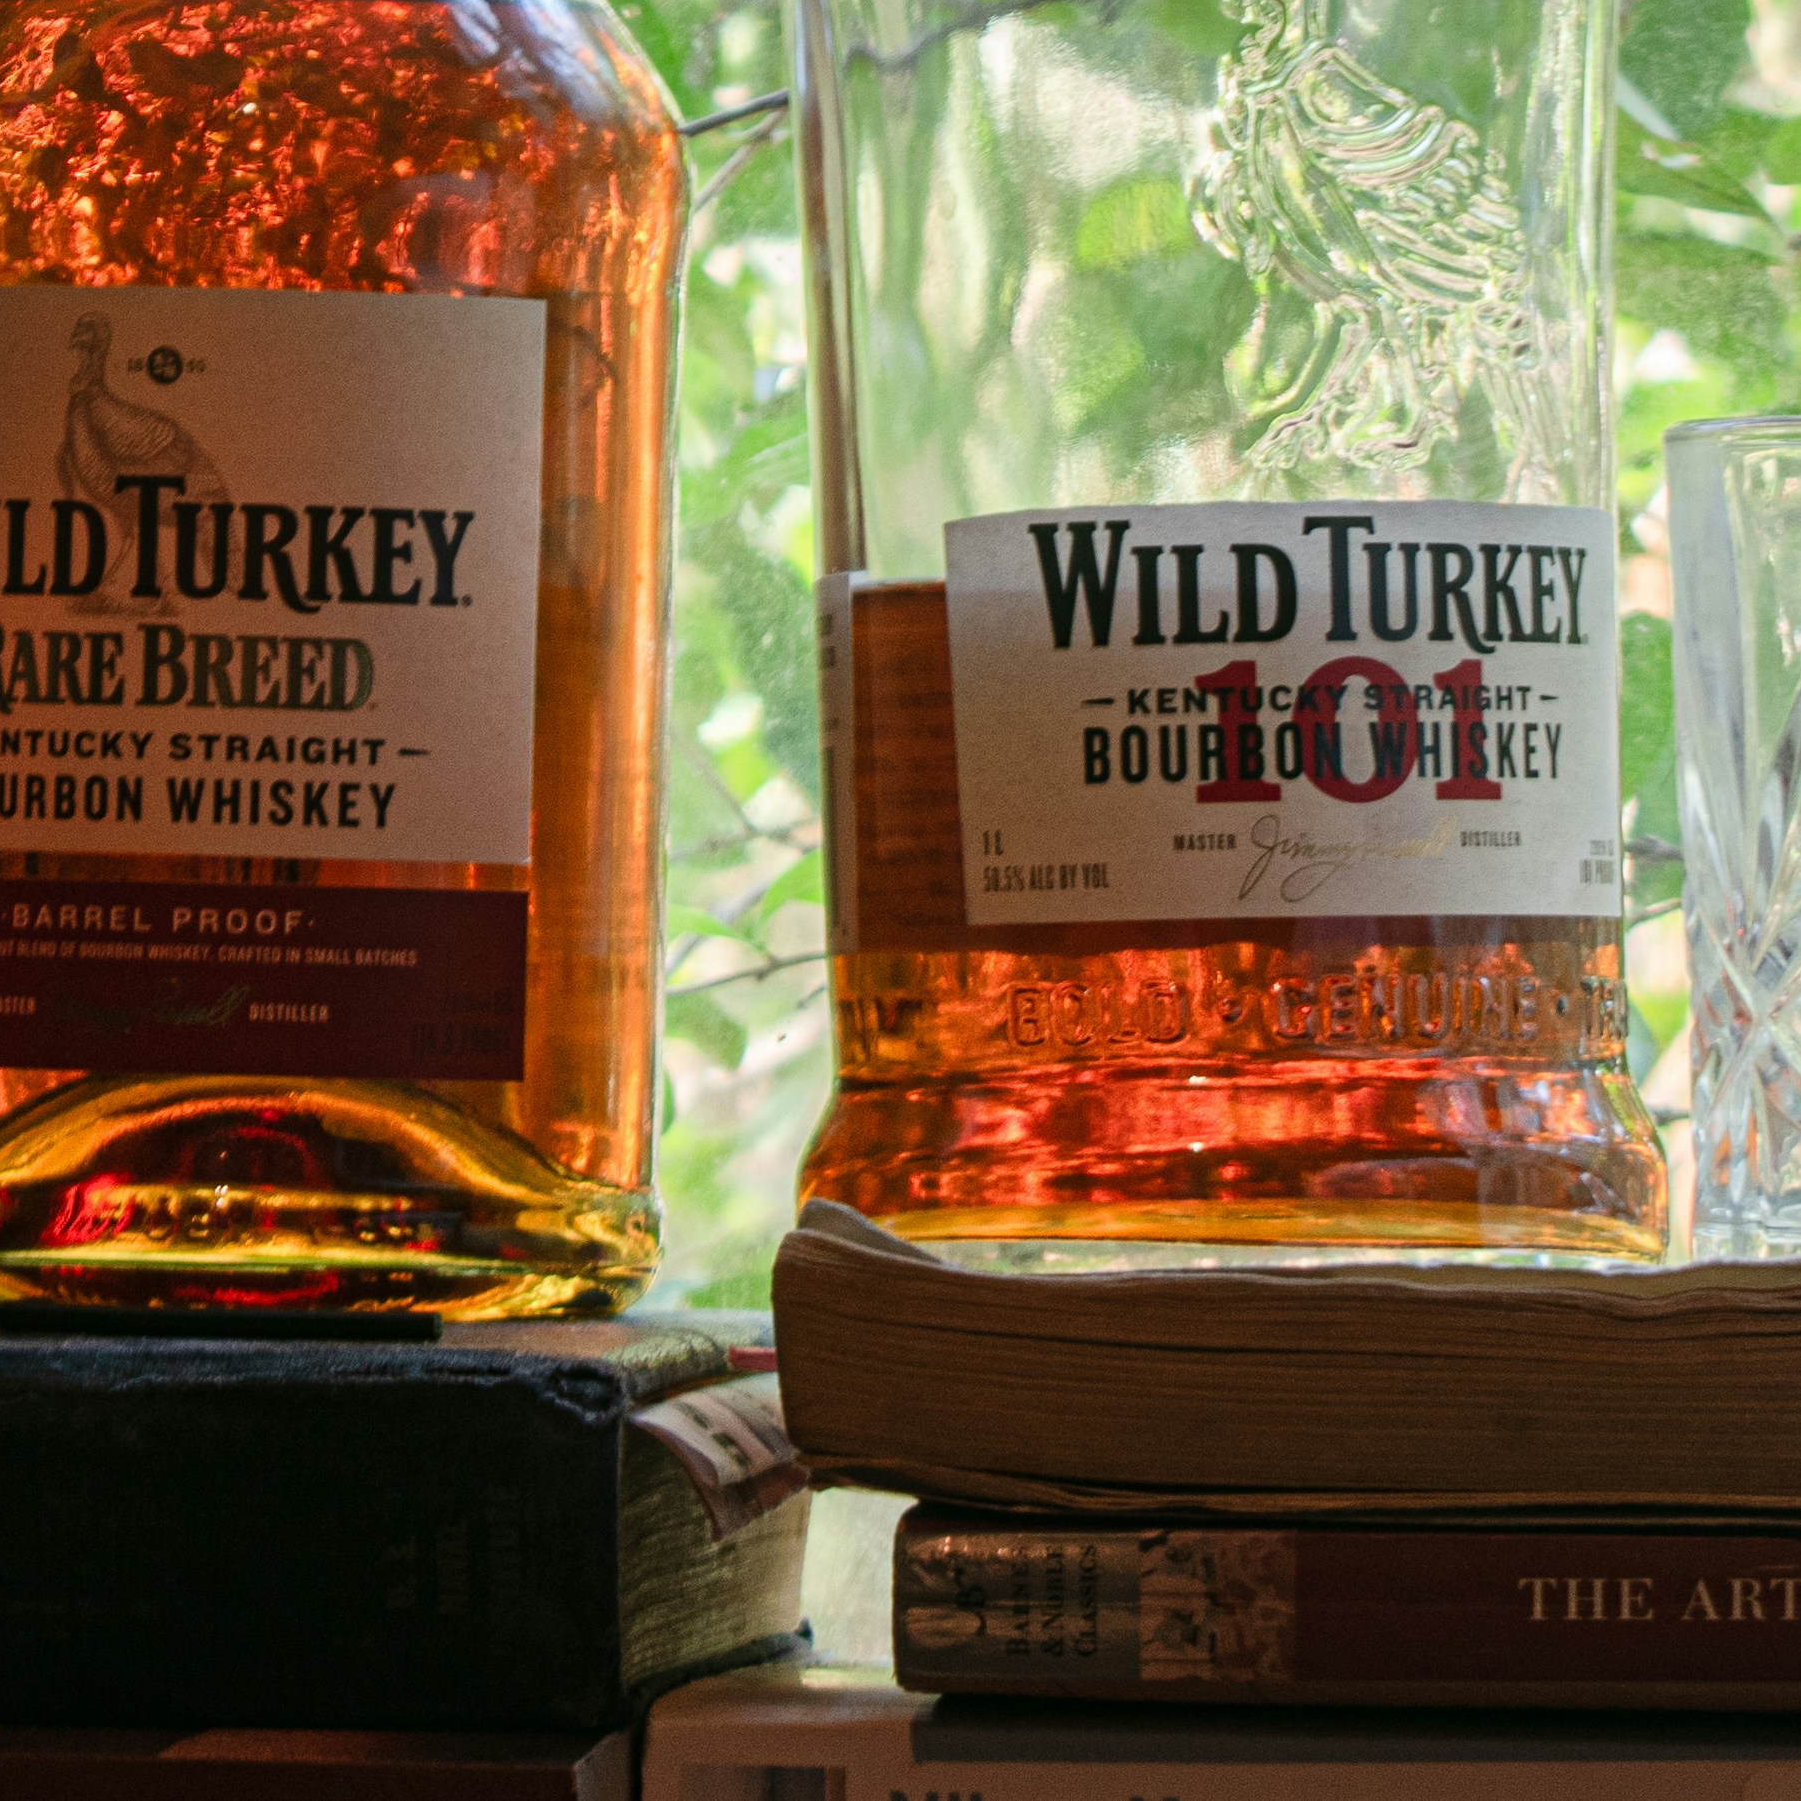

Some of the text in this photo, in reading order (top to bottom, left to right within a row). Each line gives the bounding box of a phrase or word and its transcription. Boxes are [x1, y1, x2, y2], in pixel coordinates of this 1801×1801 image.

[114, 474, 476, 615] TURKEY
[1028, 515, 1586, 656] WILD TURKEY
[133, 622, 375, 713] BREED
[1126, 683, 1529, 716] KENTUCKY STRAIGHT
[169, 732, 389, 767] STRAIGHT
[1081, 719, 1561, 785] BOURBON WHISKEY
[1194, 655, 1500, 803] 101
[167, 776, 397, 830] WHISKEY
[1172, 832, 1237, 852] MASTER
[1459, 830, 1521, 849] DISTILLER
[1028, 863, 1055, 891] ALC
[1058, 862, 1077, 890] BY
[1080, 861, 1110, 889] VOL
[11, 902, 303, 937] BARREL PROOF
[217, 944, 281, 964] CRAFTED
[284, 947, 300, 964] IN
[303, 947, 350, 966] SMALL
[354, 948, 417, 967] BATCHES
[248, 1001, 329, 1023] DISTILLER
[1006, 1547, 1031, 1657] BARNES
[1040, 1543, 1065, 1630] NOBLE
[1074, 1543, 1098, 1658] CLASSICS
[1516, 1577, 1655, 1621] THE
